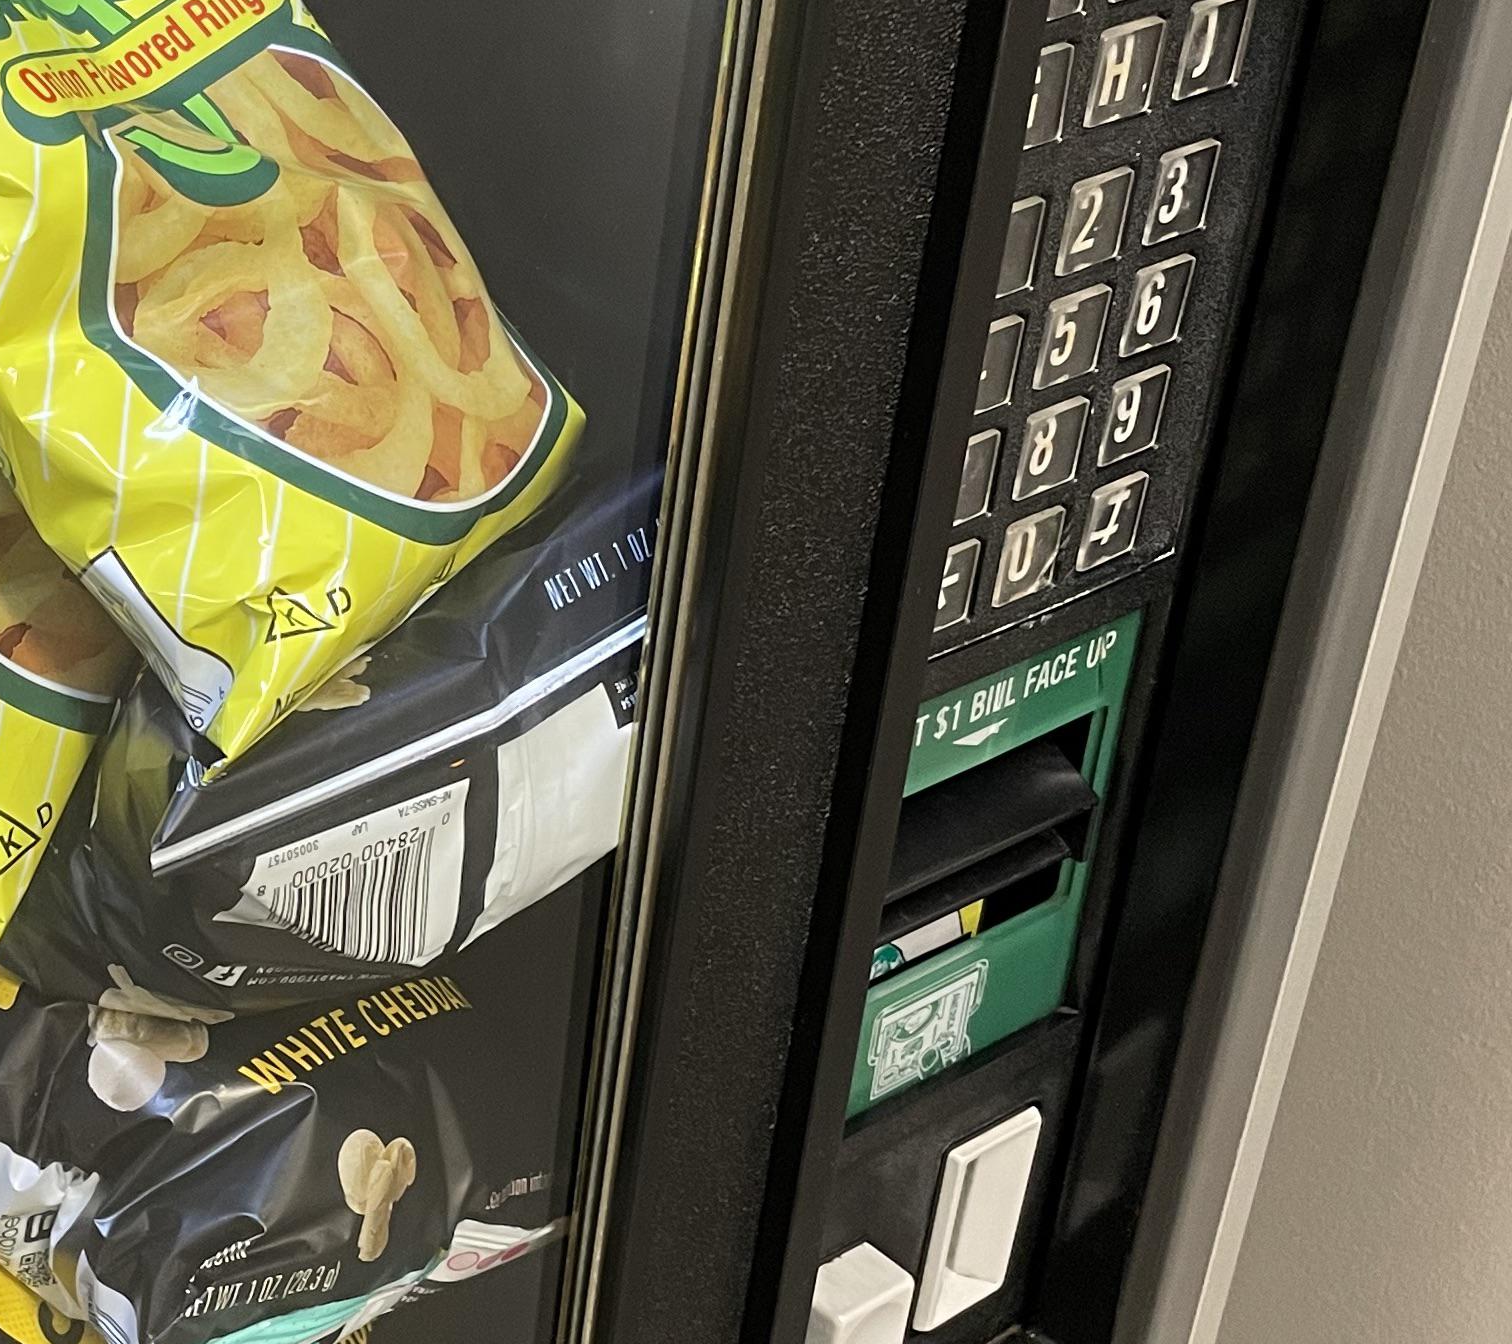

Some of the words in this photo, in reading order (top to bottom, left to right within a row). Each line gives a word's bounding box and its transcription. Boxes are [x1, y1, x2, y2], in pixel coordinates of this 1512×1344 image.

[18, 58, 90, 104] Onion
[89, 16, 196, 90] Flavored
[1098, 34, 1136, 106] H
[1190, 8, 1219, 79] J
[1070, 187, 1104, 255] 2
[1157, 155, 1190, 226] 3
[1050, 303, 1079, 368] 5
[1135, 270, 1165, 337] 6
[1028, 411, 1058, 477] 8
[1112, 382, 1142, 445] 9
[326, 587, 352, 617] D
[544, 567, 582, 611] NET
[612, 542, 628, 571] 1
[932, 705, 963, 742] $1
[1022, 643, 1078, 699] FACE
[1086, 629, 1118, 671] UP
[34, 800, 56, 829] D
[360, 827, 420, 862] 28400
[292, 852, 353, 889] 02000
[238, 1008, 368, 1095] WHITE
[283, 1265, 326, 1299] (28.3
